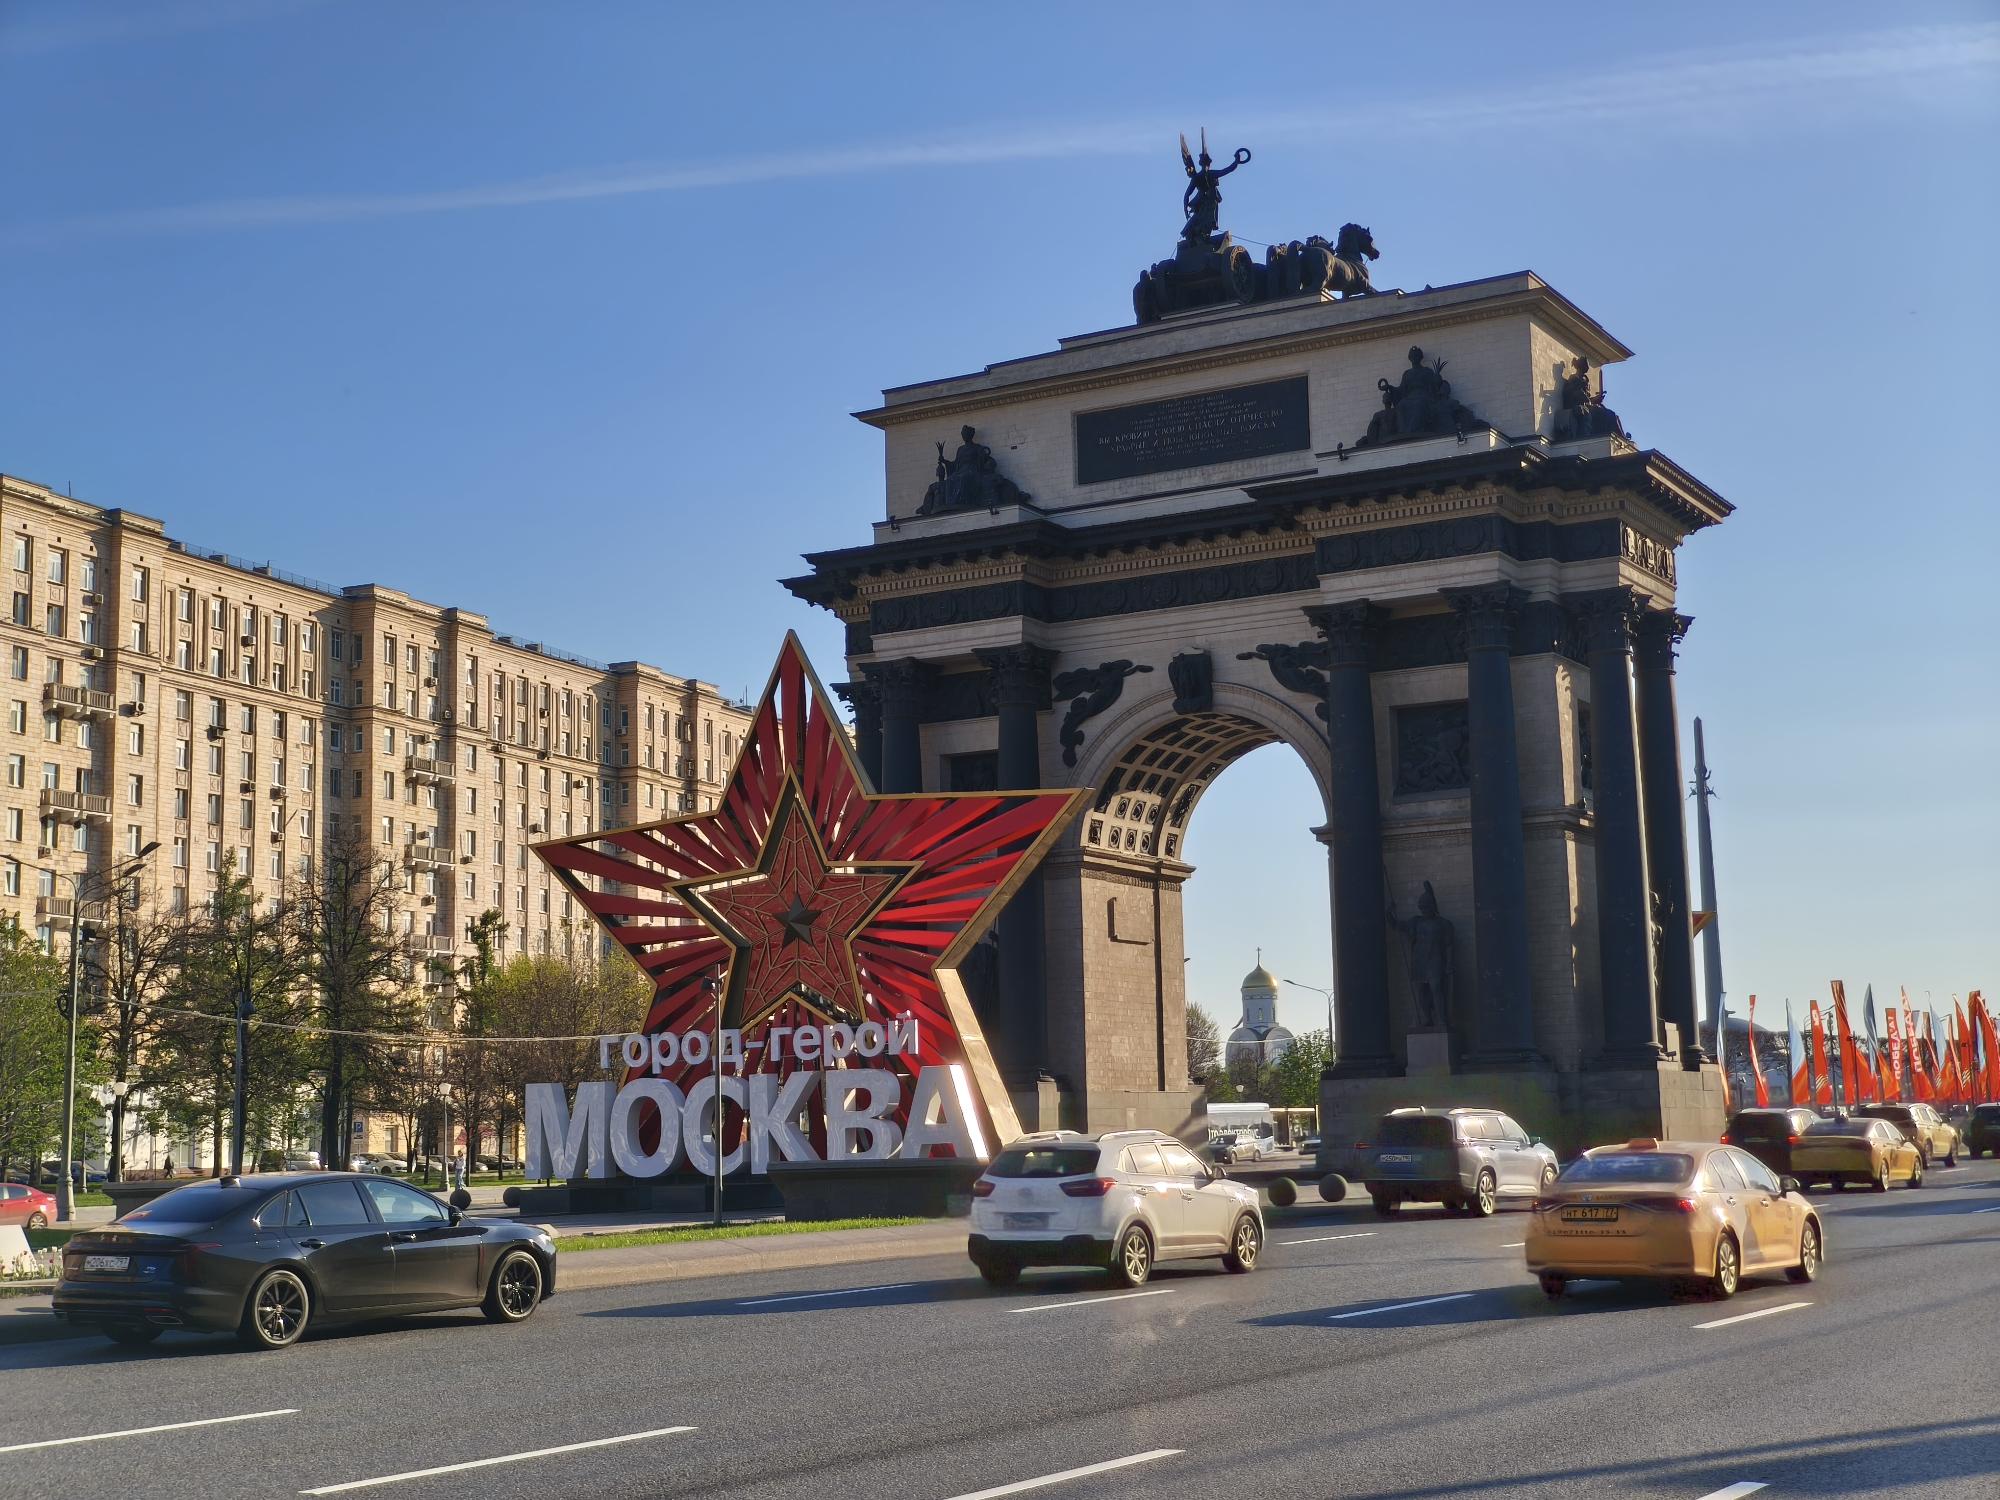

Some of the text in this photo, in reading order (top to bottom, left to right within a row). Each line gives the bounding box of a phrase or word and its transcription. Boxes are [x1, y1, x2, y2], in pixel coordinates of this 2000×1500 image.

[599, 1010, 919, 1074] город-герой
[1887, 1016, 1901, 1080] ПОБЕДА!
[525, 1064, 990, 1180] МОСКВА
[1581, 1208, 1599, 1218] 617
